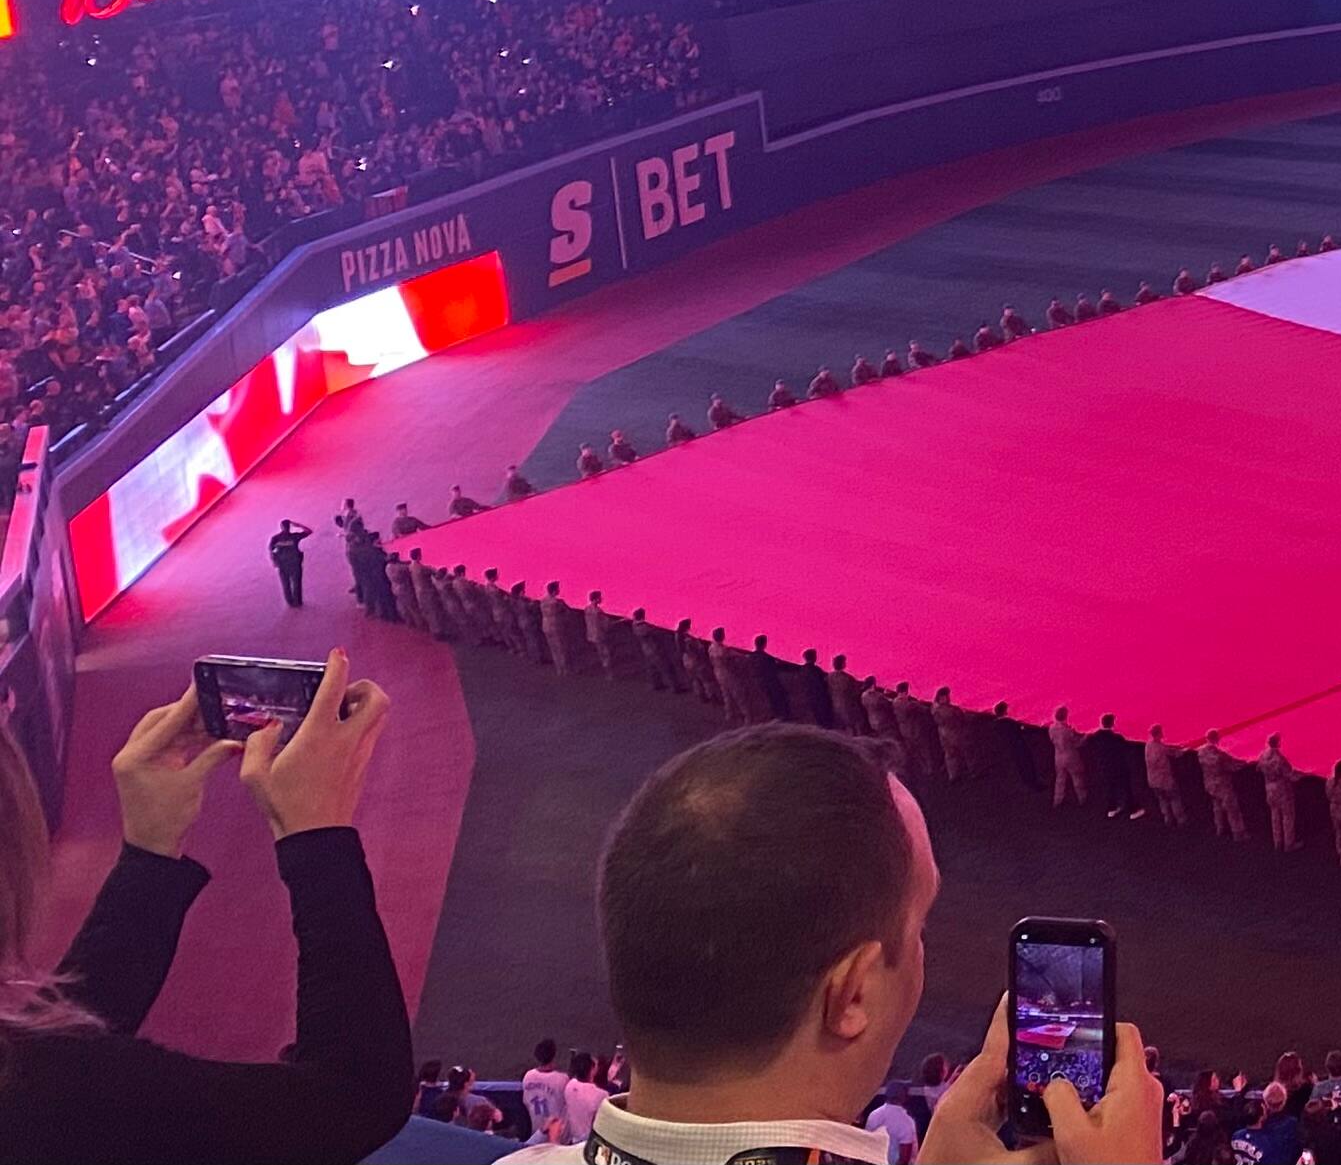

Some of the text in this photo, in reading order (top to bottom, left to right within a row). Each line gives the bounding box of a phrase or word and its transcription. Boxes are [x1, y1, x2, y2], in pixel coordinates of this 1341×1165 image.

[549, 131, 735, 264] S BET
[341, 213, 472, 292] PIZZA NOVA
